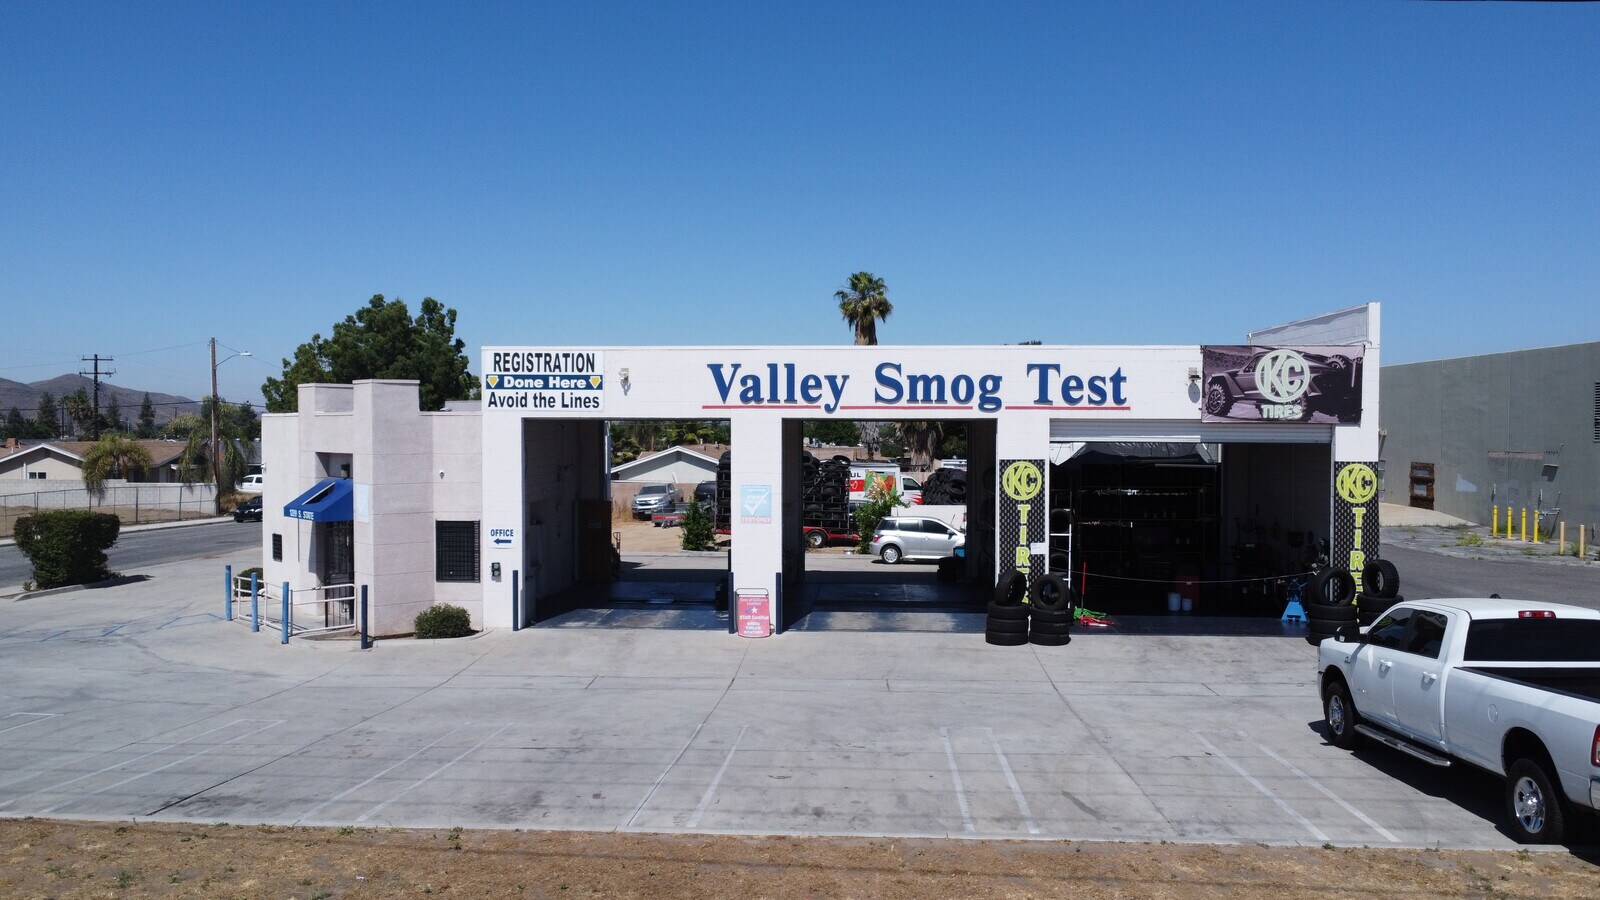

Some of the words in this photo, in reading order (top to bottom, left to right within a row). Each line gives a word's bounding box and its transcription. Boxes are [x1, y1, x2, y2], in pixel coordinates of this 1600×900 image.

[493, 352, 595, 373] REGISTRATION
[1261, 350, 1303, 400] KC
[488, 392, 528, 408] Avoid
[533, 392, 556, 408] the
[561, 392, 600, 408] Lines
[503, 376, 544, 388] Done
[548, 376, 587, 388] Here
[706, 363, 850, 413] Valley
[874, 362, 1003, 412] Smog
[1026, 363, 1128, 405] Test
[1261, 405, 1302, 419] TIRES
[1007, 462, 1038, 499] KC
[1341, 465, 1373, 502] KC
[490, 529, 514, 537] OFFICE
[1016, 504, 1031, 604] TIR
[1350, 507, 1366, 606] TIRE
